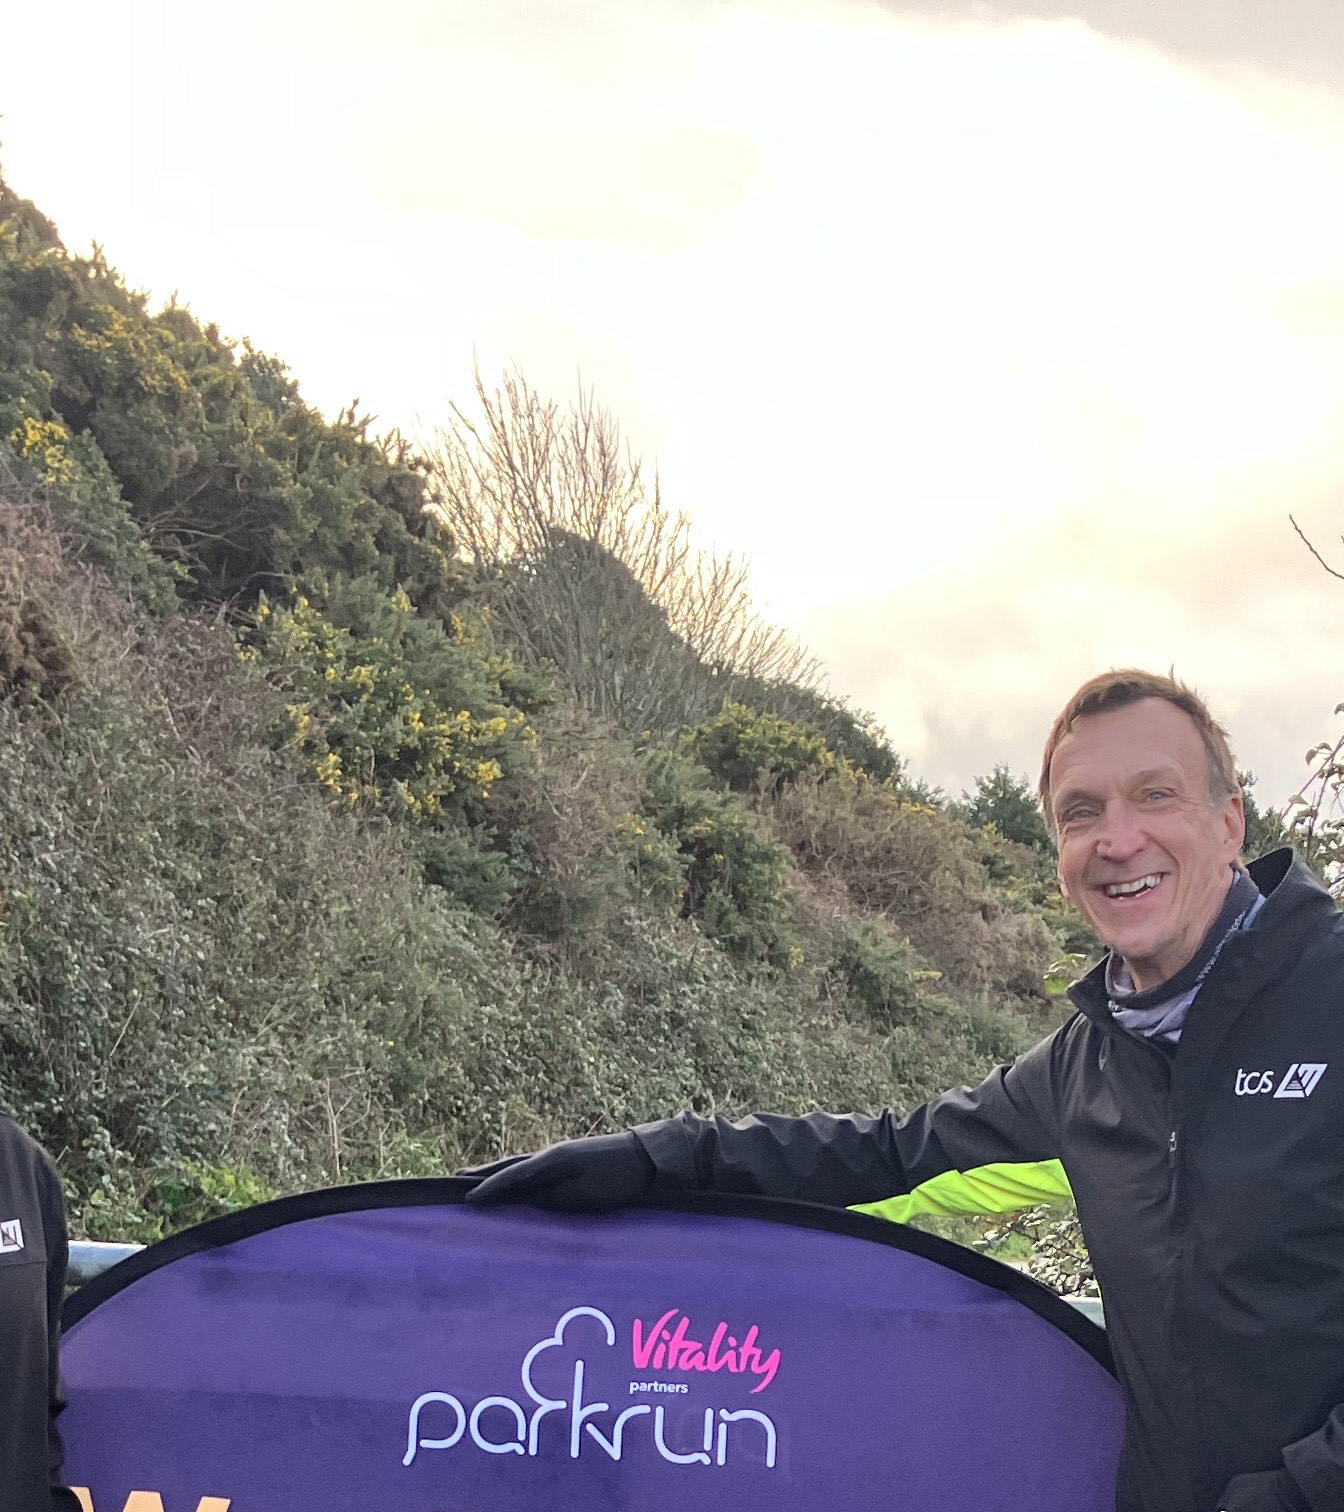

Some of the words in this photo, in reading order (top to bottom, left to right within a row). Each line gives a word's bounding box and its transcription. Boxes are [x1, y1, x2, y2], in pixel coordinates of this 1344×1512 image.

[629, 1381, 689, 1394] partners
[632, 1309, 781, 1394] Vitality
[402, 1350, 777, 1467] parkrun
